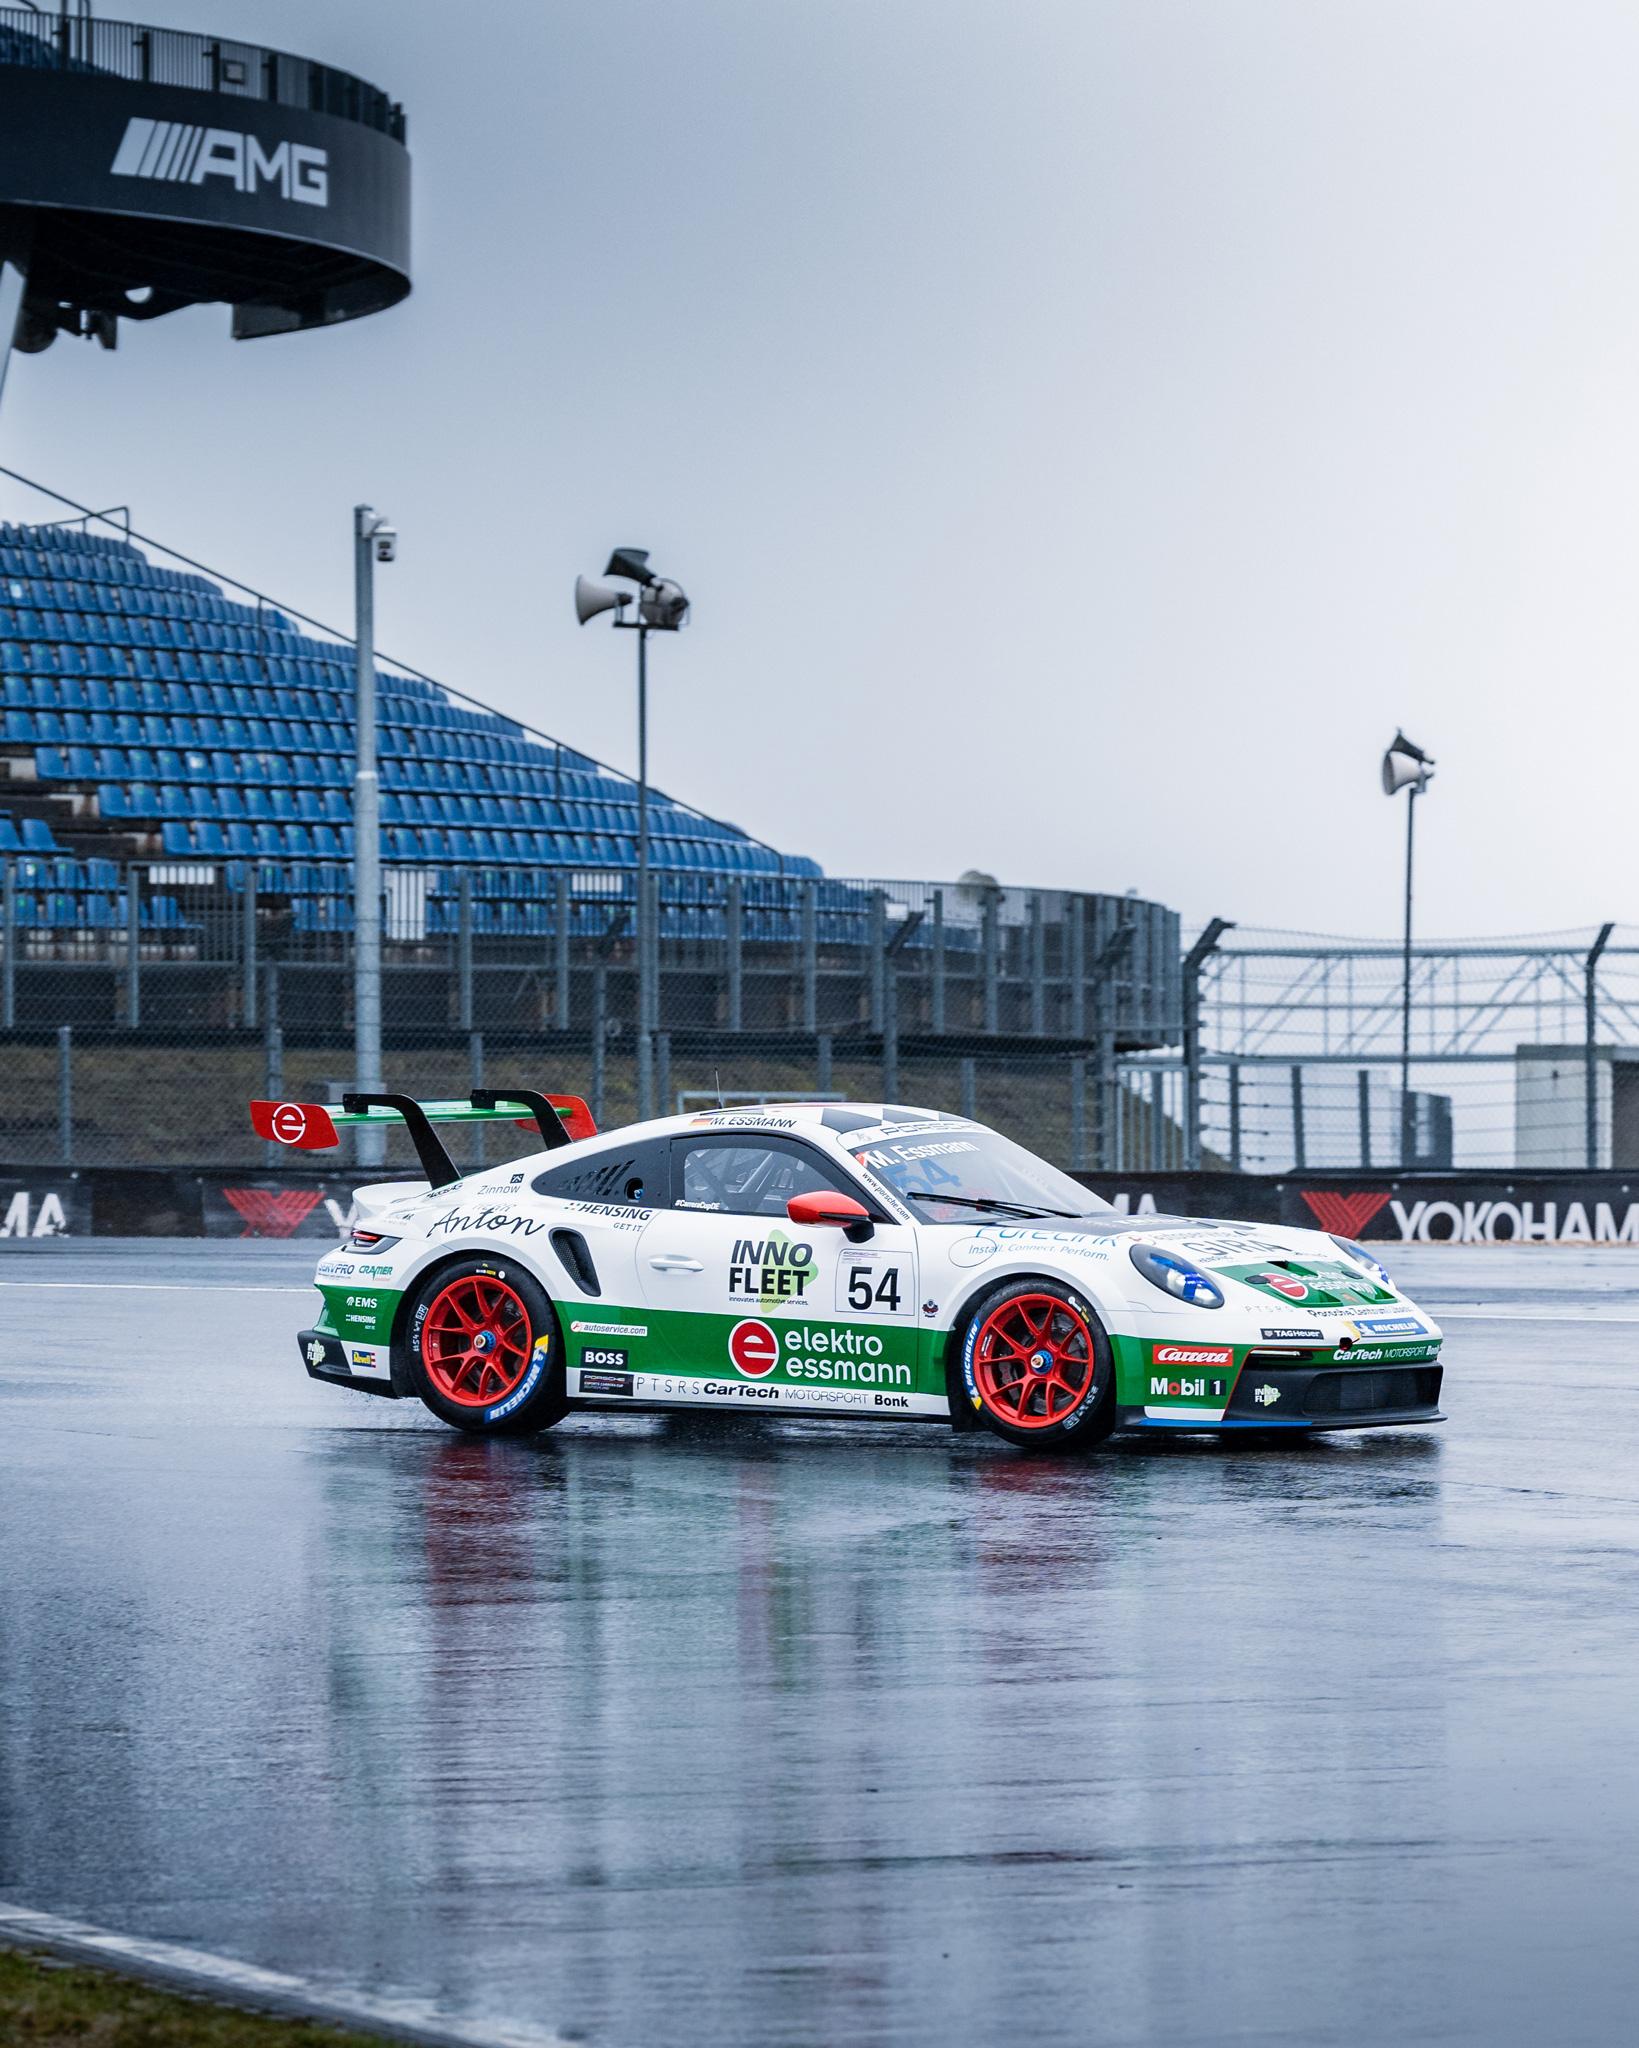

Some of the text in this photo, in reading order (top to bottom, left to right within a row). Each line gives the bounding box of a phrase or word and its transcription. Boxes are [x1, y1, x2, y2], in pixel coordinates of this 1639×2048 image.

[190, 128, 328, 208] AMG
[709, 1117, 797, 1128] M. ESSMANN
[863, 1141, 981, 1170] M. Essmann
[880, 1159, 962, 1193] 54
[862, 1171, 911, 1221] www.porsche.com
[426, 1207, 546, 1238] Anton
[578, 1203, 653, 1221] HENSING
[730, 1239, 813, 1268] INNO
[1059, 1245, 1110, 1261] Perform.
[358, 1264, 393, 1281] CRAMER
[728, 1267, 810, 1296] FLEET
[847, 1265, 902, 1312] 54
[354, 1297, 378, 1309] EMS
[583, 1323, 646, 1336] autoservice.com
[1372, 1321, 1420, 1332] MICHELIN
[784, 1326, 884, 1357] elektro
[963, 1322, 979, 1387] MICHELIN
[1333, 1347, 1383, 1361] CarTech
[1384, 1346, 1427, 1358] MOTORSPORT
[584, 1350, 624, 1366] BOSS
[1157, 1347, 1230, 1364] Carrera
[785, 1357, 912, 1386] essmann
[703, 1382, 910, 1408] CarTech MOTORSPORT Bonk
[1150, 1377, 1221, 1396] Mobil 1
